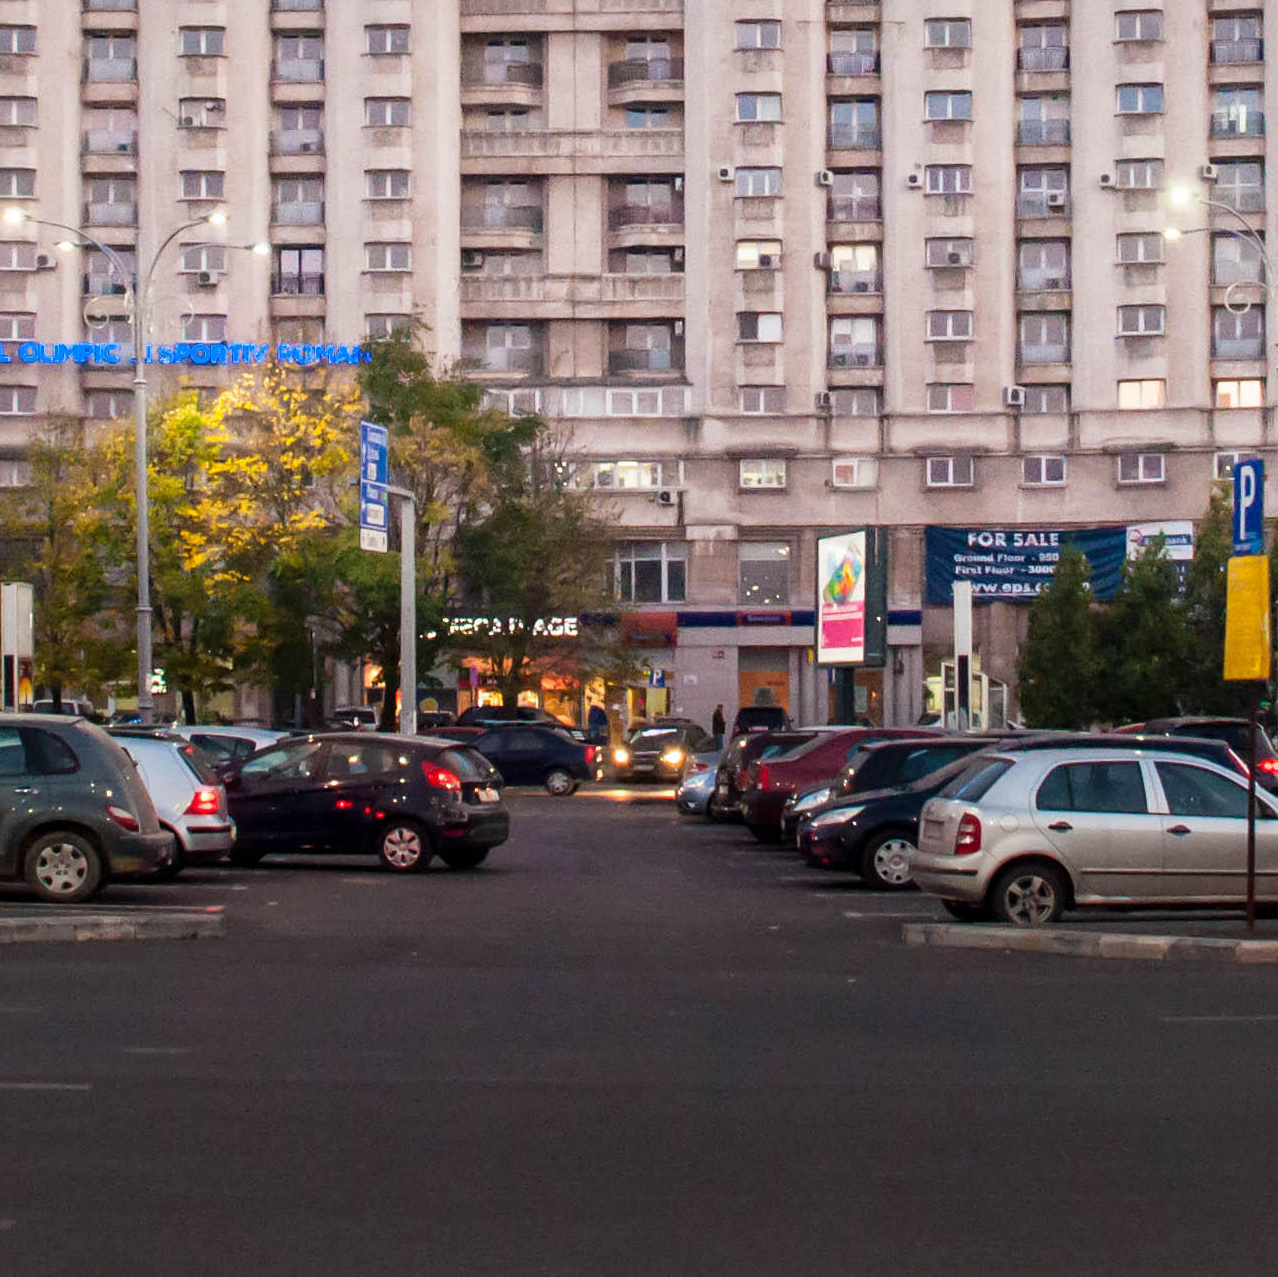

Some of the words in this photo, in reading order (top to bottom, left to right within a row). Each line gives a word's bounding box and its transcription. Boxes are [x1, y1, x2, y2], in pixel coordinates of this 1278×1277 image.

[18, 341, 120, 364] OLIMPIC
[158, 342, 268, 365] SPORTIV
[1240, 465, 1256, 541] P
[968, 532, 1007, 547] FOR
[1013, 533, 1060, 547] SALE
[954, 553, 994, 563] Ground
[997, 553, 1026, 563] Floor
[955, 565, 983, 575] First
[985, 565, 1014, 575] Floor
